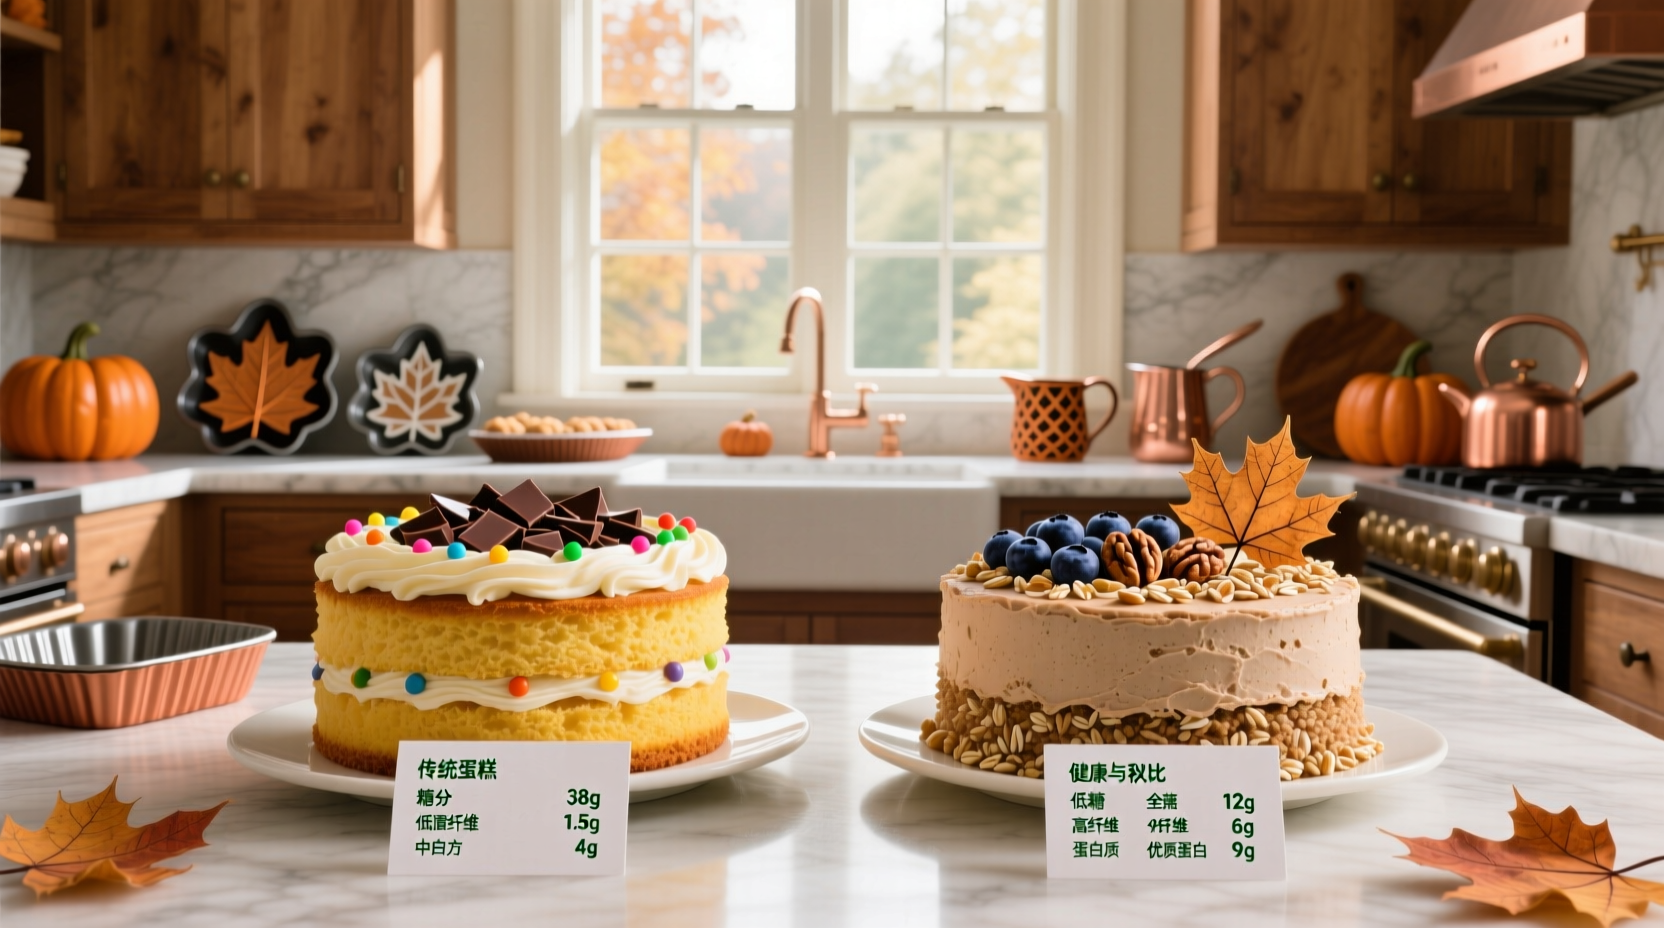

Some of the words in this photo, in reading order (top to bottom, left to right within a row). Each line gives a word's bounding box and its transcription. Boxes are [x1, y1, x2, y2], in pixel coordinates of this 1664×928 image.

[417, 757, 497, 781] 传统蛋糕
[416, 787, 453, 807] 糖分
[567, 788, 601, 811] 38g
[1222, 792, 1255, 815] 12g
[563, 813, 600, 835] 1.5g
[1231, 817, 1255, 839] 6g
[414, 837, 463, 857] 中白方
[574, 838, 598, 860] 4g
[1072, 840, 1120, 859] 蛋白质
[1231, 840, 1255, 863] 9g
